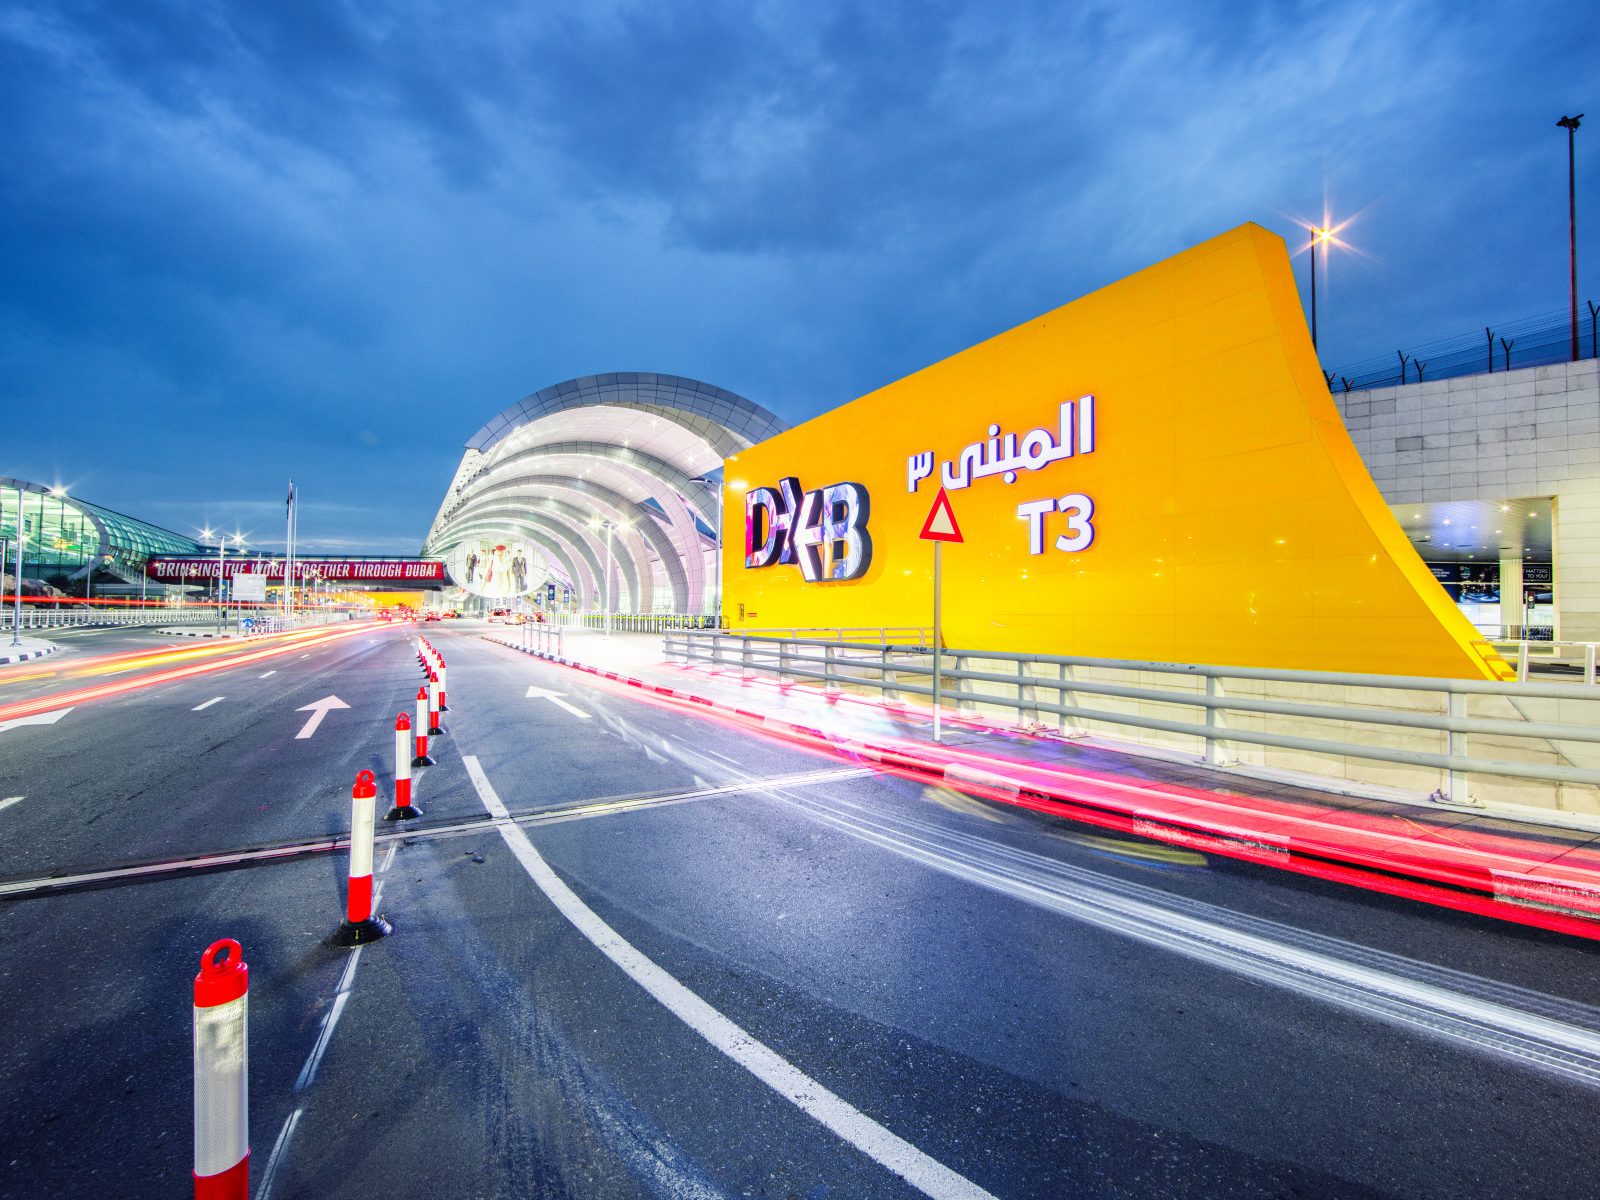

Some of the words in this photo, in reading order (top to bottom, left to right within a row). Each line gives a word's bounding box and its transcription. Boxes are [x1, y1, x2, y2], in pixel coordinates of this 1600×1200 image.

[907, 450, 935, 493] ٣
[941, 394, 1095, 491] المبنى
[745, 476, 873, 583] DXB
[1017, 493, 1096, 555] T3
[157, 562, 221, 577] BRINGING
[225, 562, 248, 577] THE
[296, 563, 350, 577] TOGETHER
[354, 563, 402, 577] THROUGH
[405, 564, 437, 577] DUBAI
